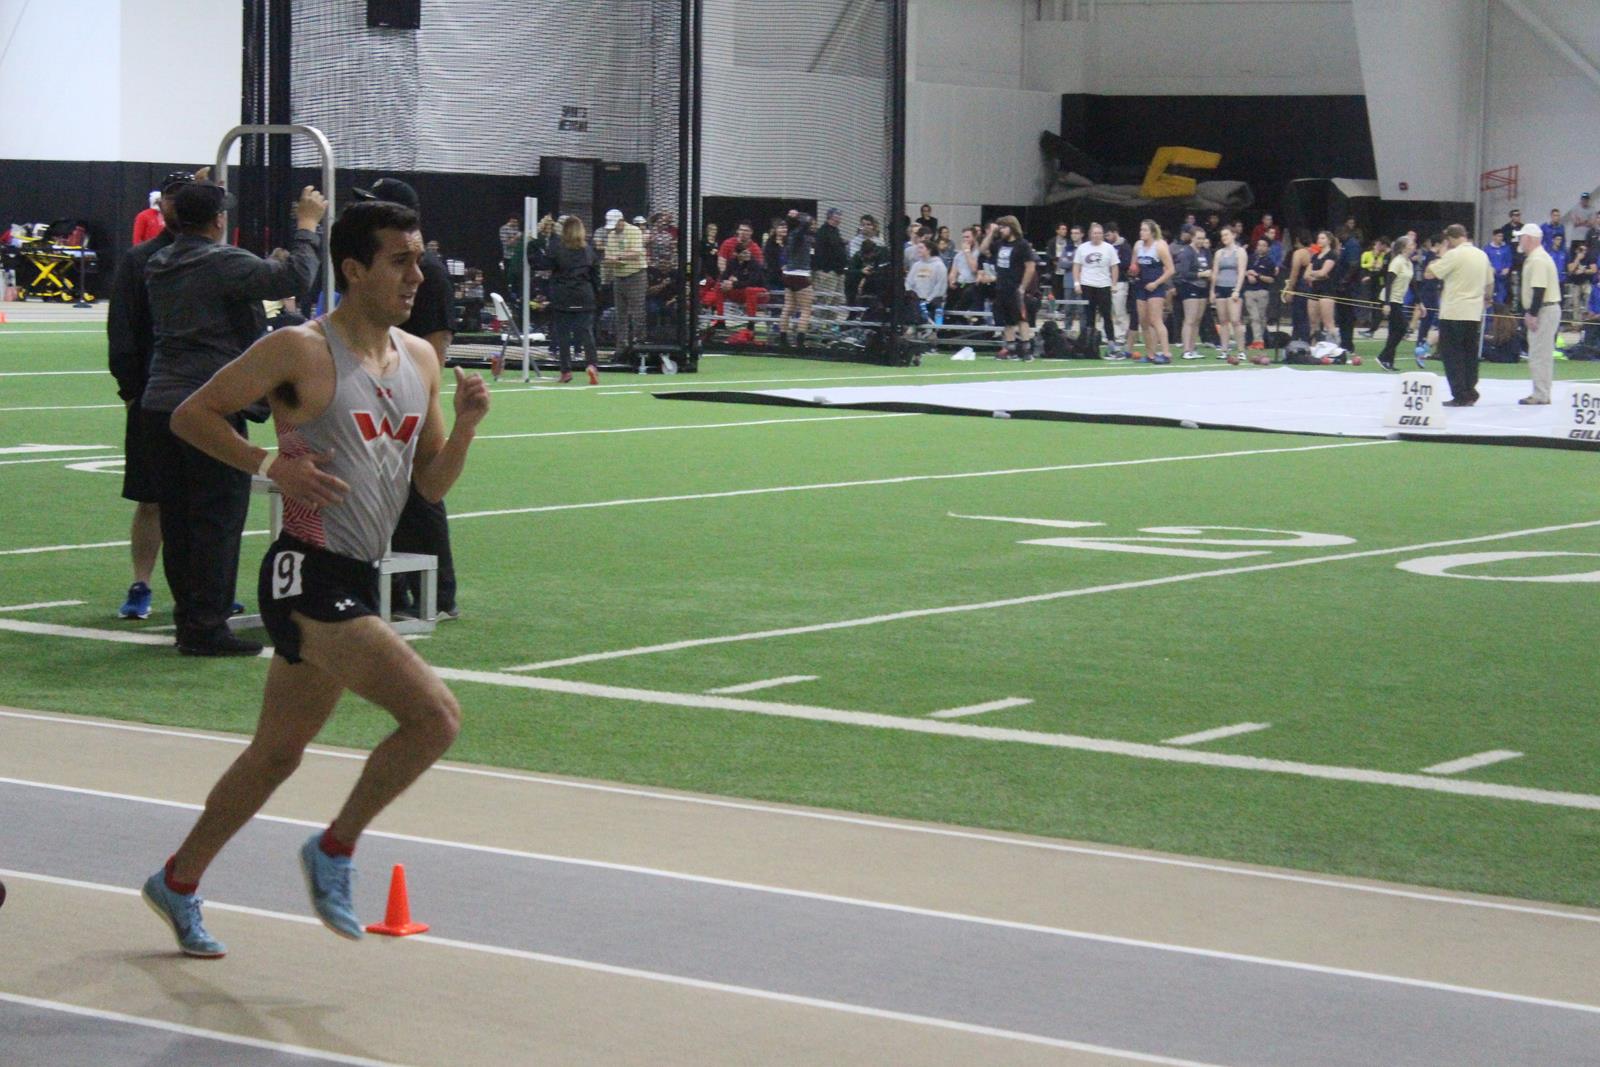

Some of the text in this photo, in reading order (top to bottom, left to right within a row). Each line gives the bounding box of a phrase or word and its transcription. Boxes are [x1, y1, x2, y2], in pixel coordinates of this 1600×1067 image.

[1402, 380, 1432, 396] 14m
[1398, 415, 1430, 426] GILL
[278, 553, 295, 595] 9
